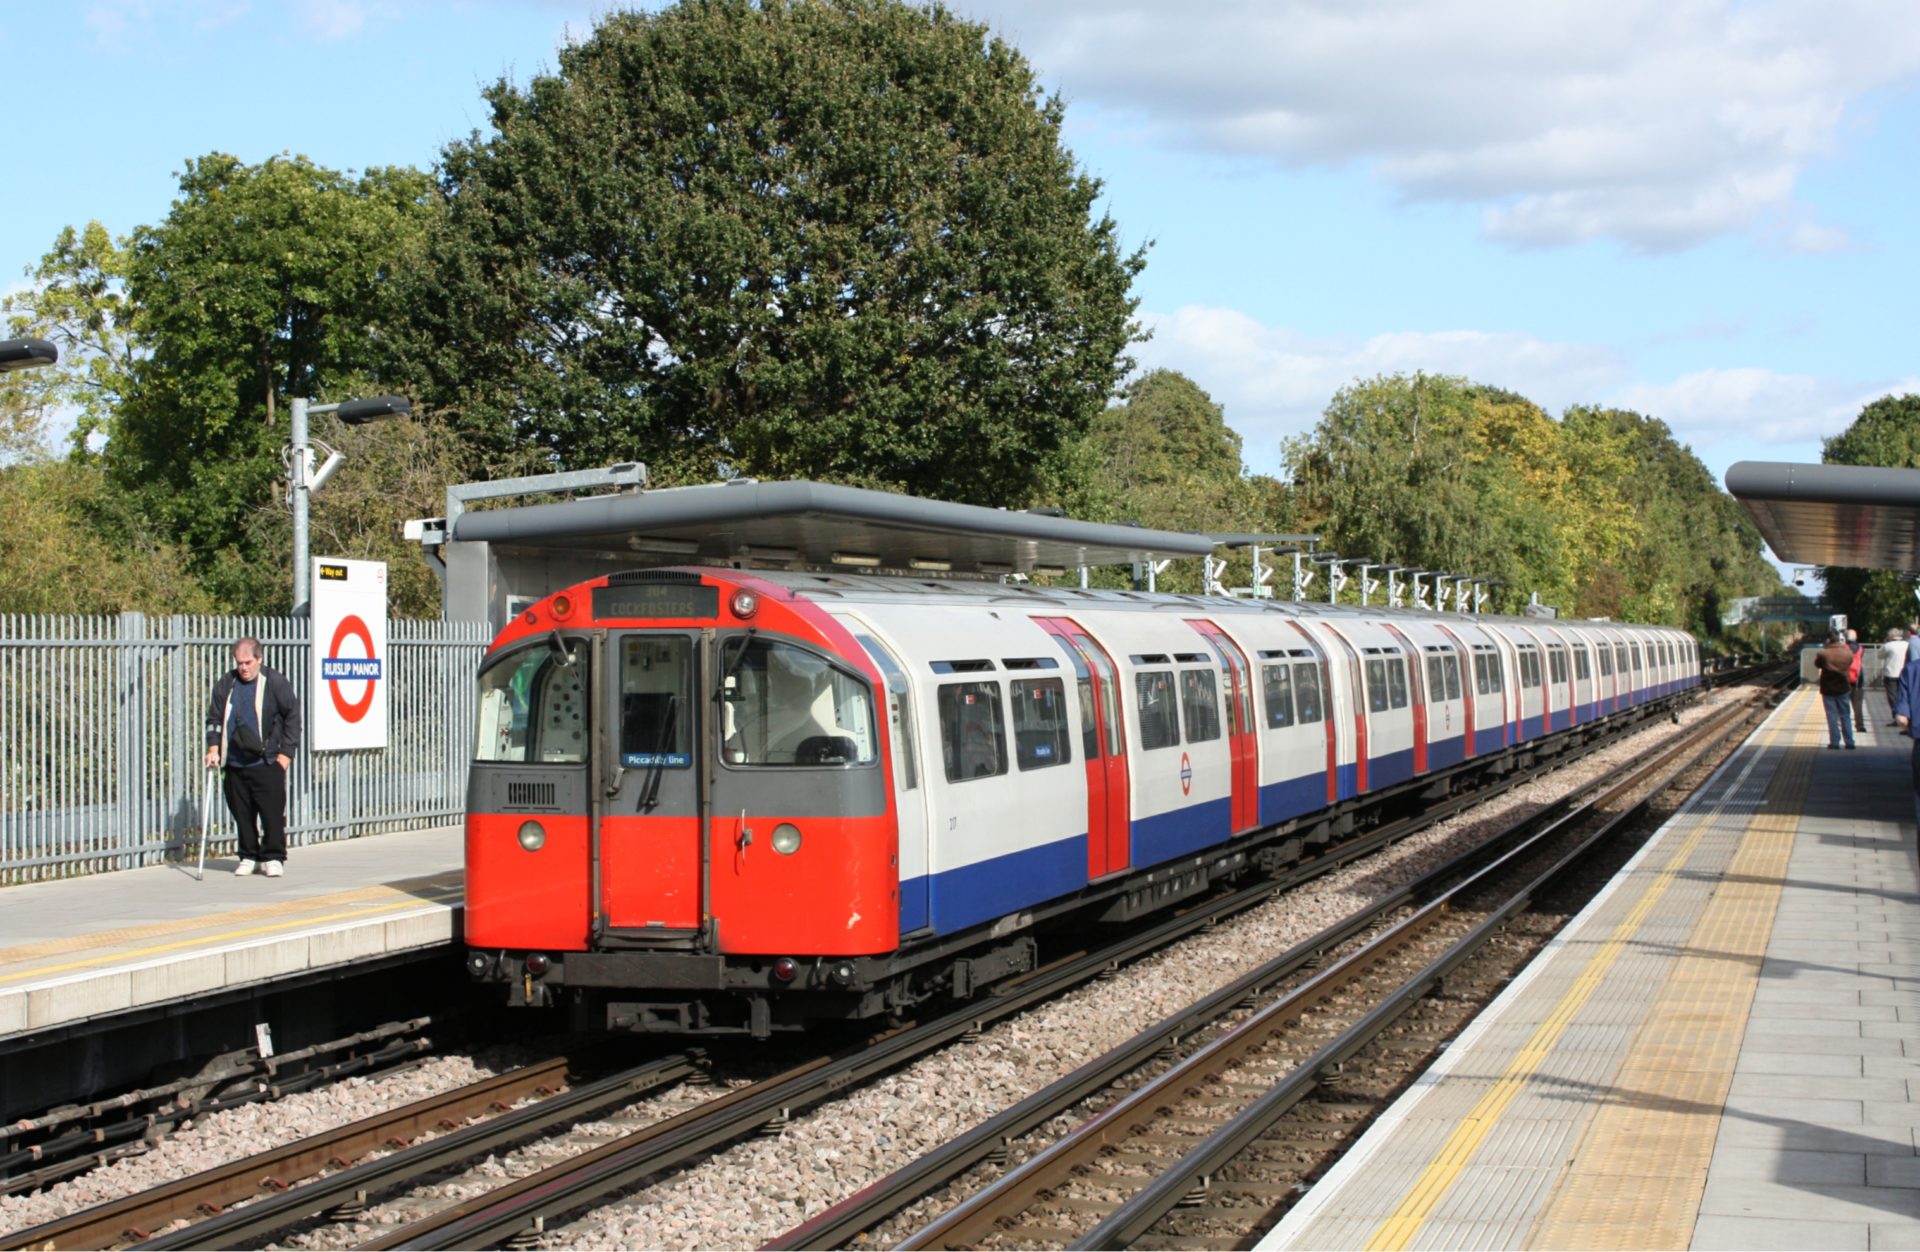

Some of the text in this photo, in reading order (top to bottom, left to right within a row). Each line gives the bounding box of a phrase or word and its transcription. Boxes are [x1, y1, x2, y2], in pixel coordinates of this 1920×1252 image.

[325, 567, 343, 577] Way out
[610, 602, 695, 616] COCKFOSTERS
[324, 662, 379, 676] RUISLIP MANOR
[668, 755, 685, 764] line
